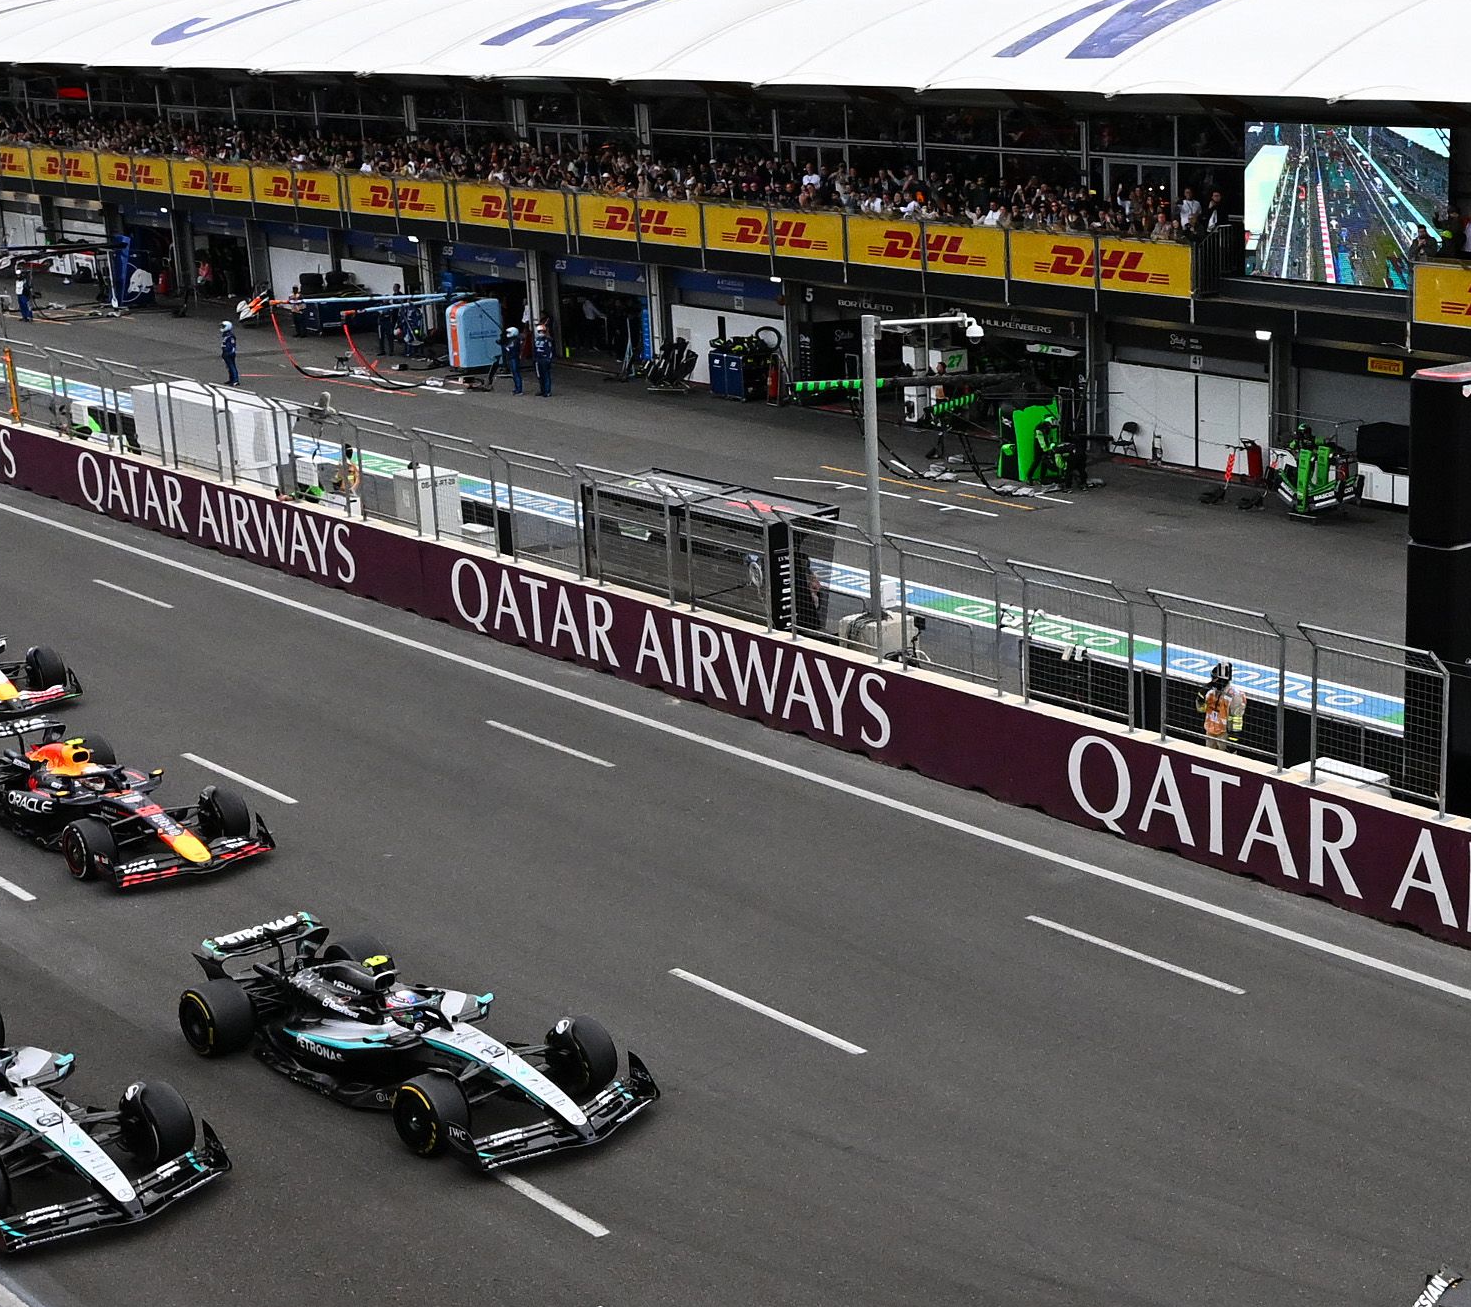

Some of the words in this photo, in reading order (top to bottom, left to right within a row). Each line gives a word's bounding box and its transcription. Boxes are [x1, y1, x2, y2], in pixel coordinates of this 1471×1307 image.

[46, 157, 84, 178] DHL
[114, 162, 156, 185] DHL
[189, 170, 234, 192] DHL
[272, 177, 321, 201] DHL
[369, 186, 425, 211] DHL
[481, 195, 543, 223] DHL
[605, 206, 673, 235] DHL
[735, 217, 813, 249] DHL
[883, 230, 971, 265] DHL
[555, 260, 567, 270] 23
[1051, 245, 1152, 283] DHL
[805, 287, 814, 302] 5
[838, 299, 894, 312] BORTOLETO
[948, 353, 964, 368] 27
[77, 450, 188, 534] QATAR
[197, 489, 356, 584] AIRWAYS
[954, 603, 1120, 647] aramco
[451, 557, 619, 668] QATAR
[635, 609, 890, 750] AIRWAYS
[1170, 656, 1363, 706] aramco
[8, 791, 54, 814] ORACLE
[1067, 734, 1363, 899] QATAR
[215, 915, 297, 946] PETRONAS
[296, 1033, 343, 1062] PETRONAS
[448, 1125, 466, 1141] IWC
